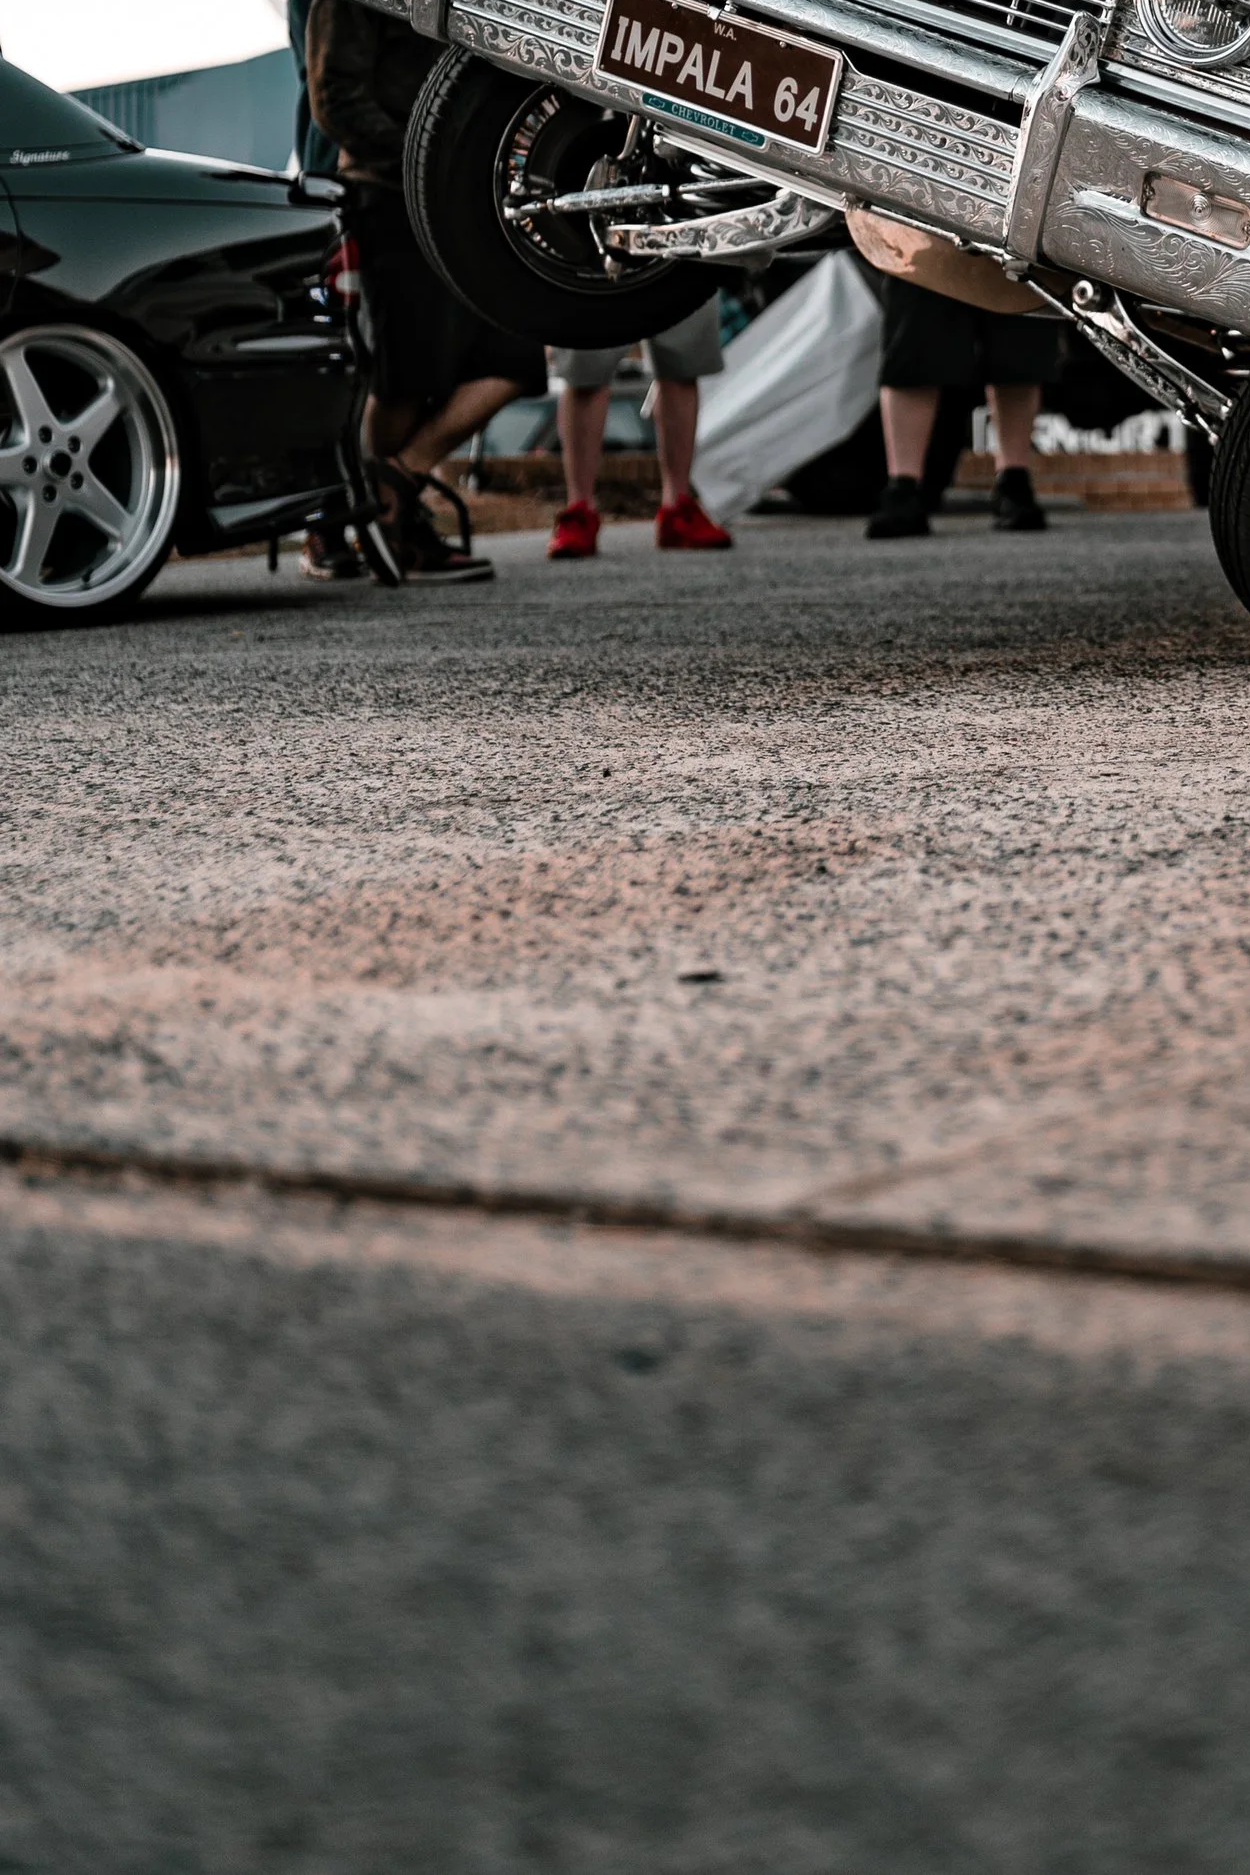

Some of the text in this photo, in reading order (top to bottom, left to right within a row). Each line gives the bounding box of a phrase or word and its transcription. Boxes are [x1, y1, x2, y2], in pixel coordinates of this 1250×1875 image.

[713, 21, 737, 41] W.A.
[610, 15, 820, 132] IMPALA 64
[671, 104, 736, 135] CHEVROLET
